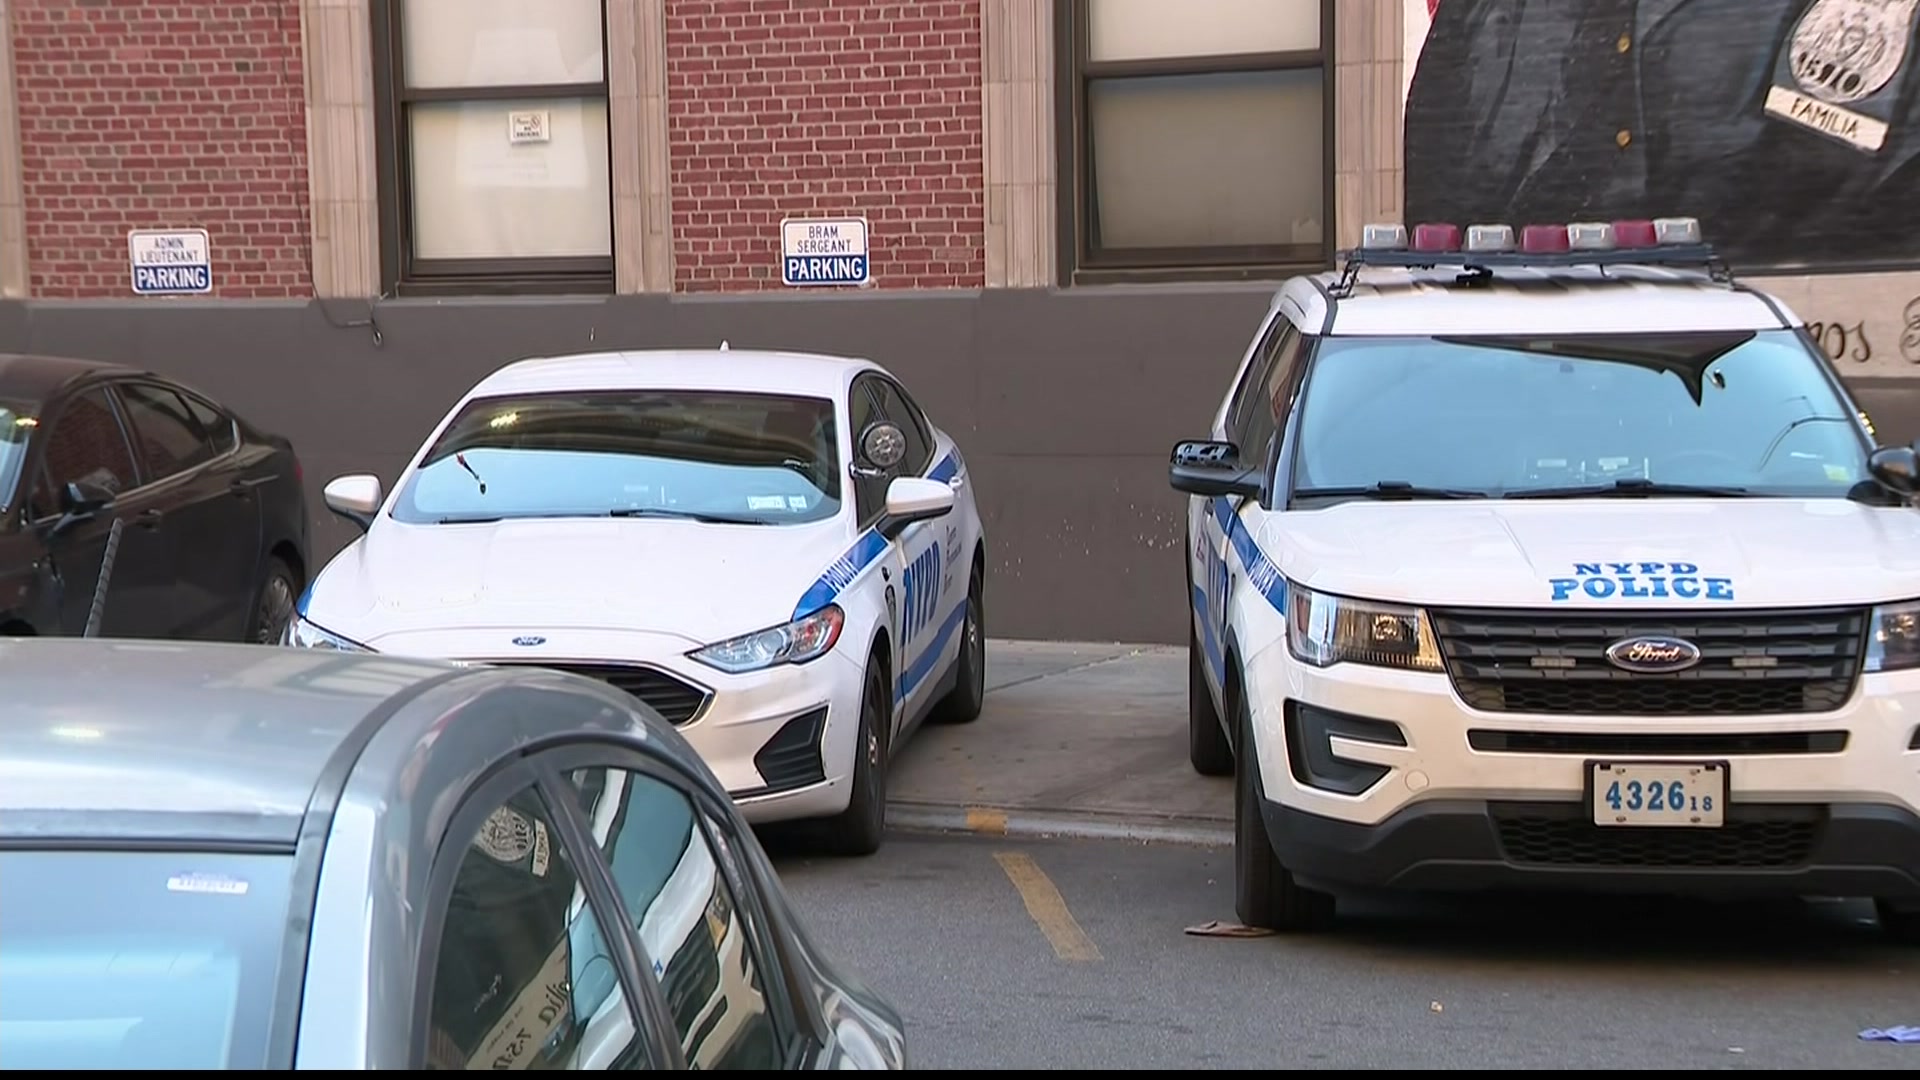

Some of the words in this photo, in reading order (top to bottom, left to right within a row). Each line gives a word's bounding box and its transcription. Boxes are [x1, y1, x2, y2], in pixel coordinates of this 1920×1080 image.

[1790, 97, 1860, 139] FAMILIA
[808, 225, 839, 239] BRAM
[154, 237, 184, 249] ADMIN
[797, 239, 852, 254] SERGEANT
[140, 249, 199, 264] LIEUTENANT
[136, 266, 207, 289] PARKING
[788, 257, 863, 280] PARKING
[1572, 562, 1699, 575] NYPD
[1549, 577, 1735, 601] POLICE
[1628, 641, 1681, 662] Ford
[1605, 780, 1685, 811] 4326
[1690, 796, 1713, 812] 18
